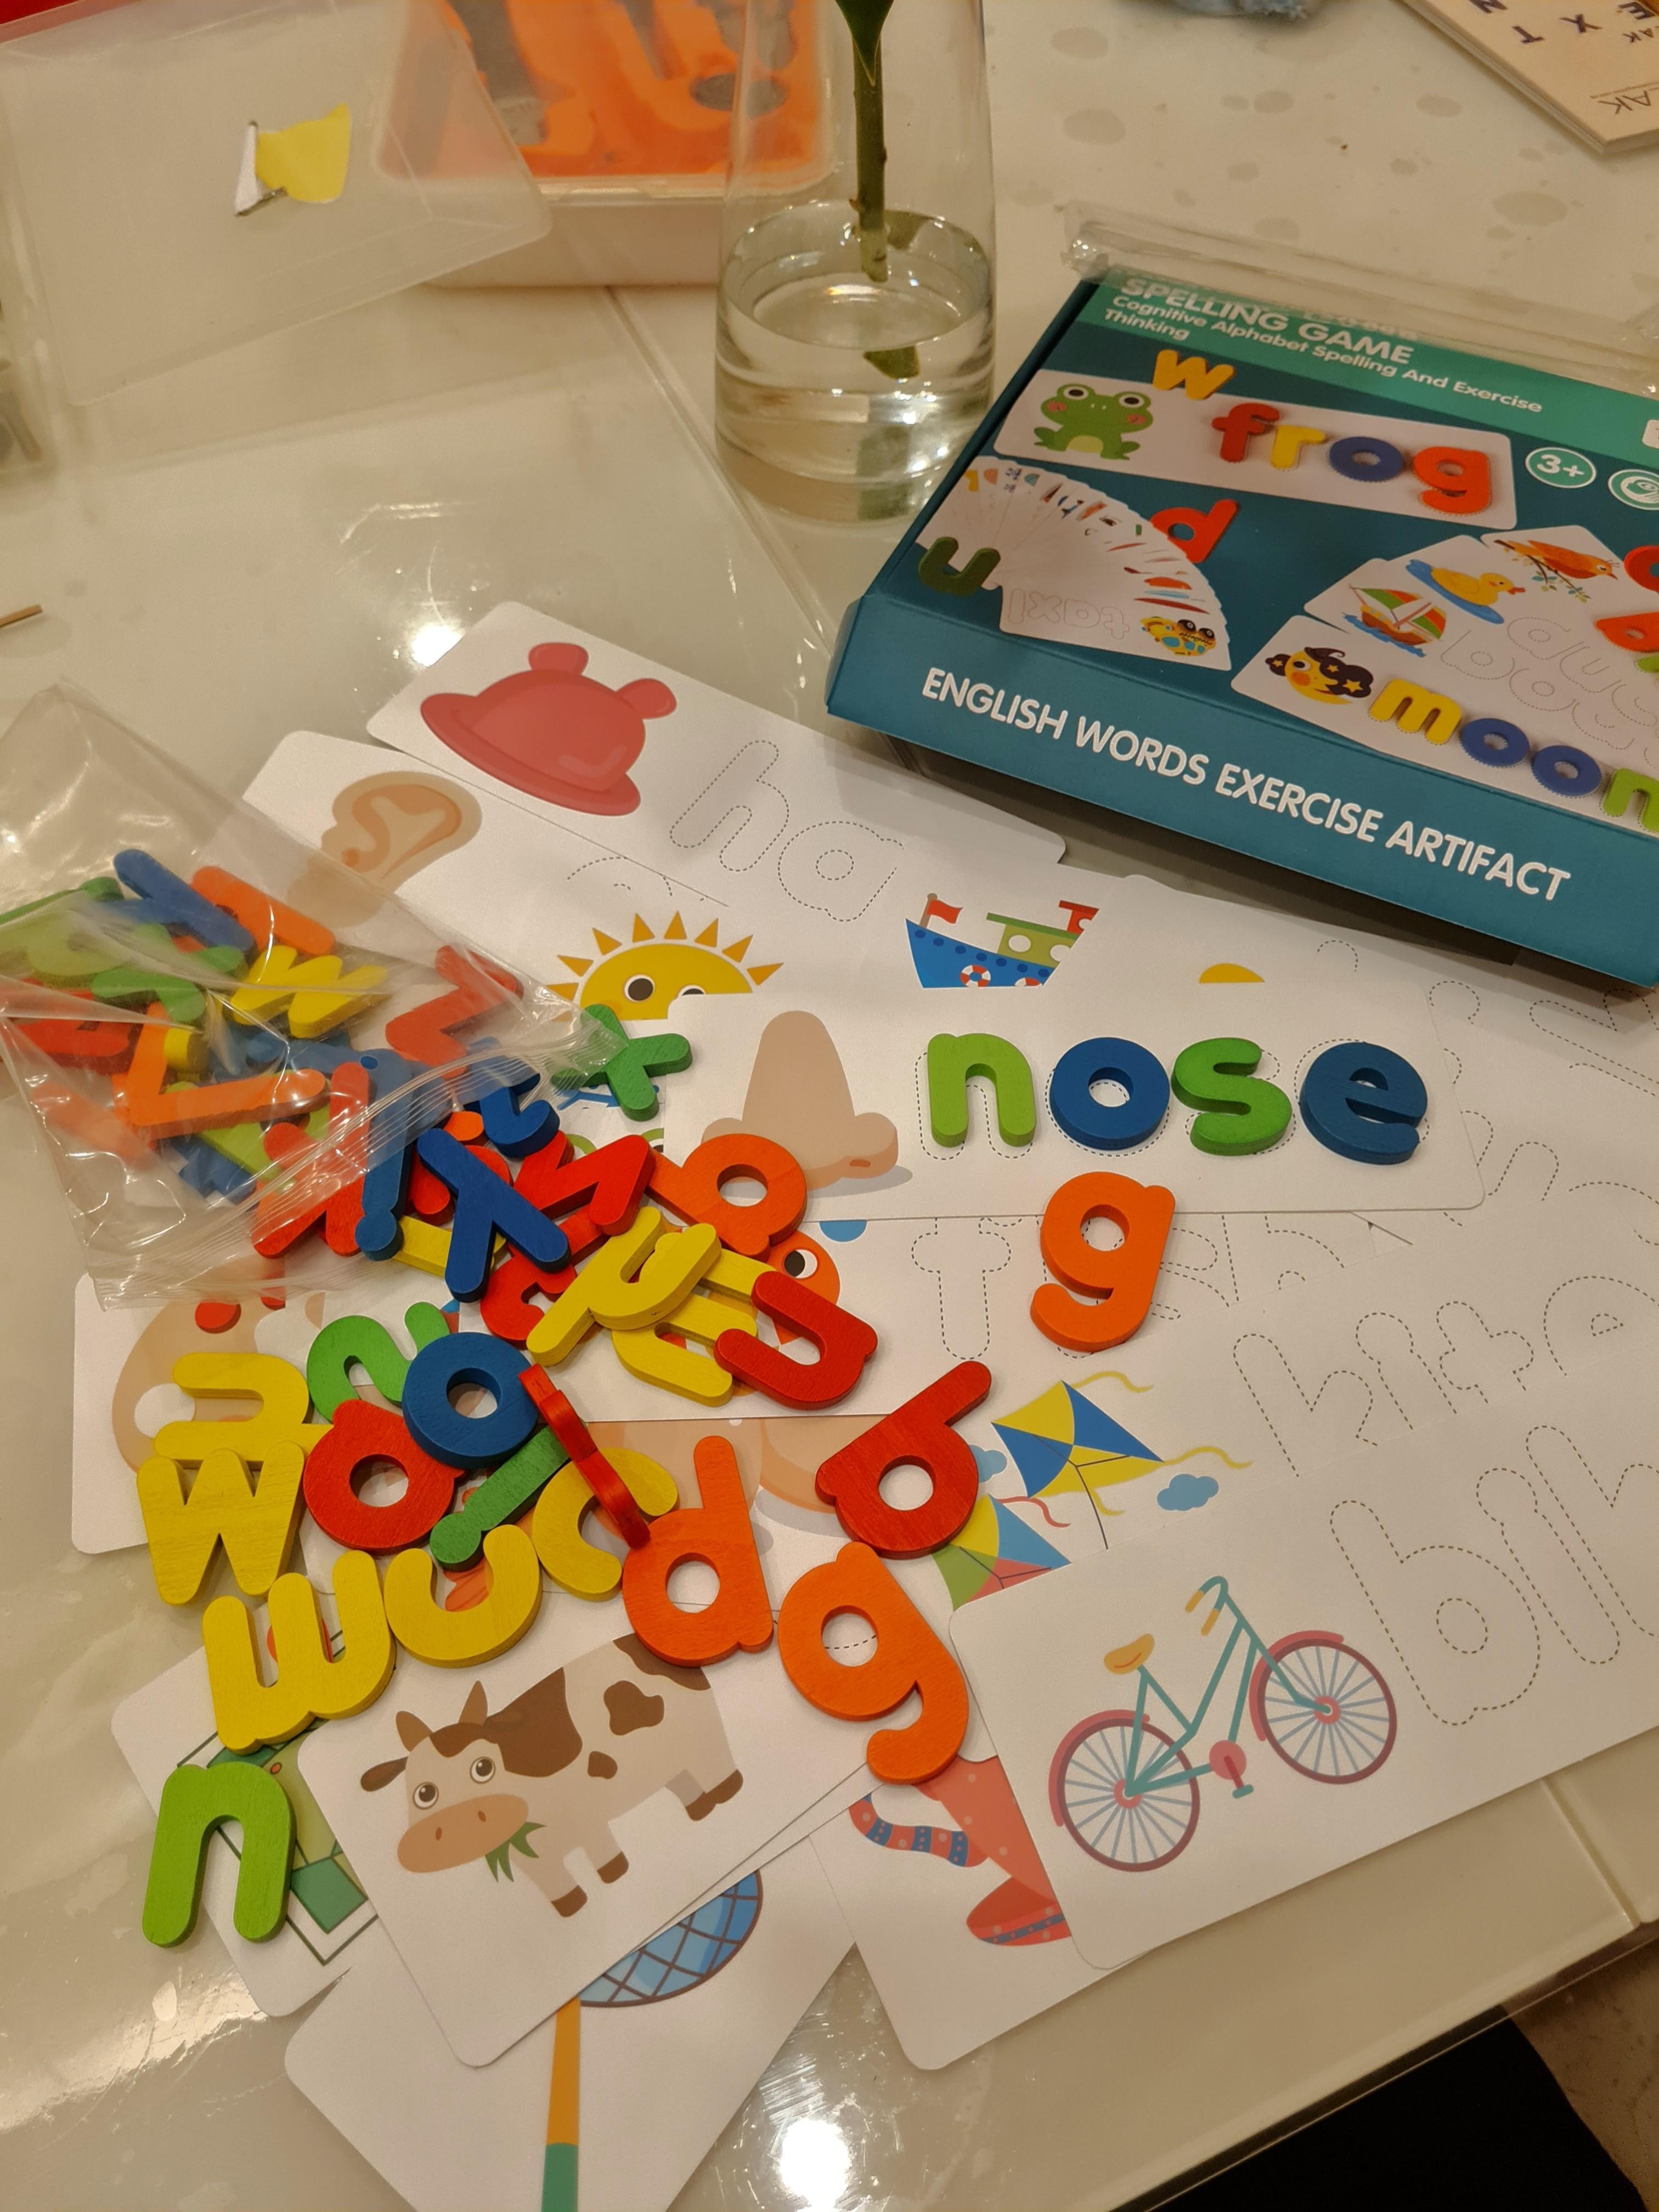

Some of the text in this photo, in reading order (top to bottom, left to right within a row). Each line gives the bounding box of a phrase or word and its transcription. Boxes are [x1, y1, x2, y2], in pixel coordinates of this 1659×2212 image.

[1104, 308, 1190, 342] Thinking
[1112, 296, 1206, 327] Cognitive
[1211, 320, 1309, 353] Alphabet
[1312, 345, 1398, 377] Spelling
[1402, 368, 1448, 390] And
[1453, 379, 1543, 413] Exercise
[1120, 277, 1289, 331] SPELLING
[1299, 322, 1415, 365] GAME
[1211, 402, 1492, 514] frog
[1536, 454, 1585, 478] 3+
[922, 667, 1571, 901] ENGLISH WORDS EXERCISE ARTIFACT
[916, 1031, 1430, 1166] nose
[1030, 1171, 1176, 1353] g
